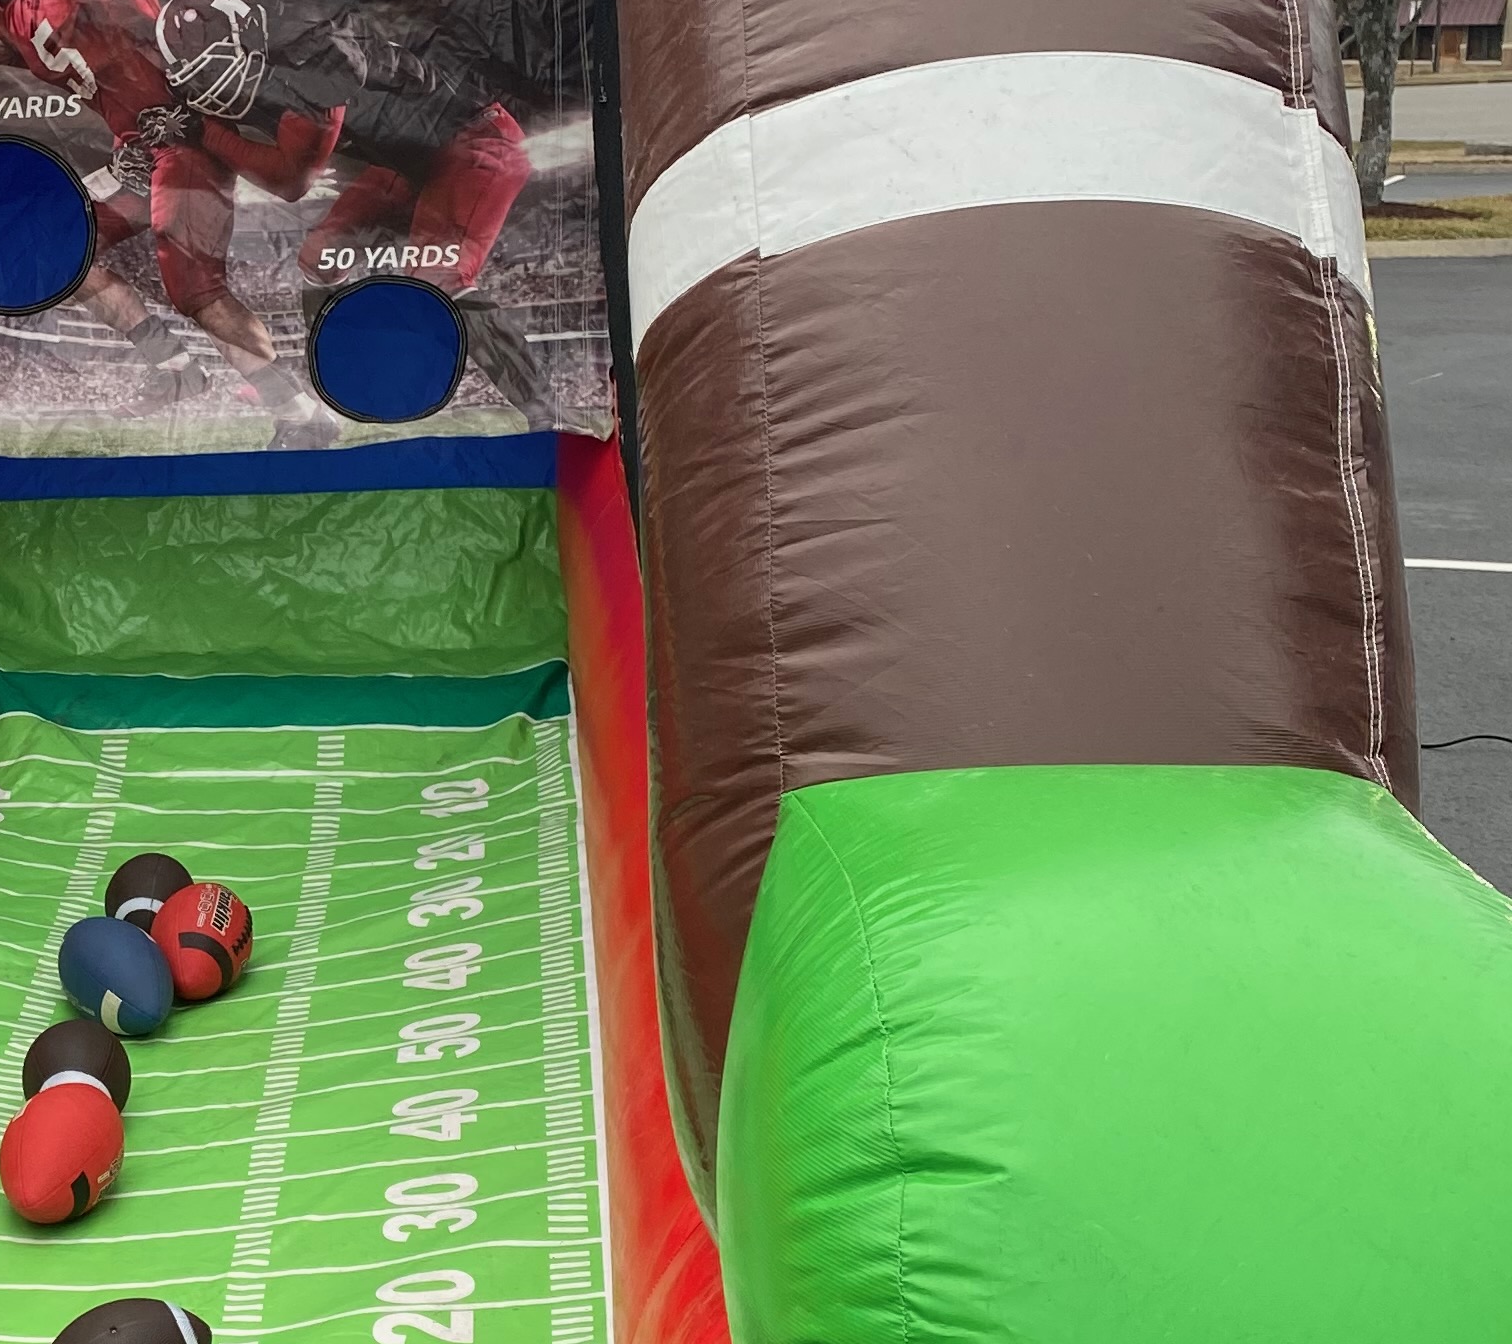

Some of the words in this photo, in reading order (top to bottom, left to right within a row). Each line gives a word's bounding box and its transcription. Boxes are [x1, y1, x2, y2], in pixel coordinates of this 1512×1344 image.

[317, 247, 356, 270] 50
[364, 244, 460, 269] YARDS
[420, 777, 490, 818] 10
[210, 885, 238, 936] anklin
[407, 876, 484, 927] 30
[402, 942, 483, 990] 40
[397, 1012, 482, 1064] 50
[389, 1088, 479, 1142] 40
[382, 1173, 479, 1243] 30
